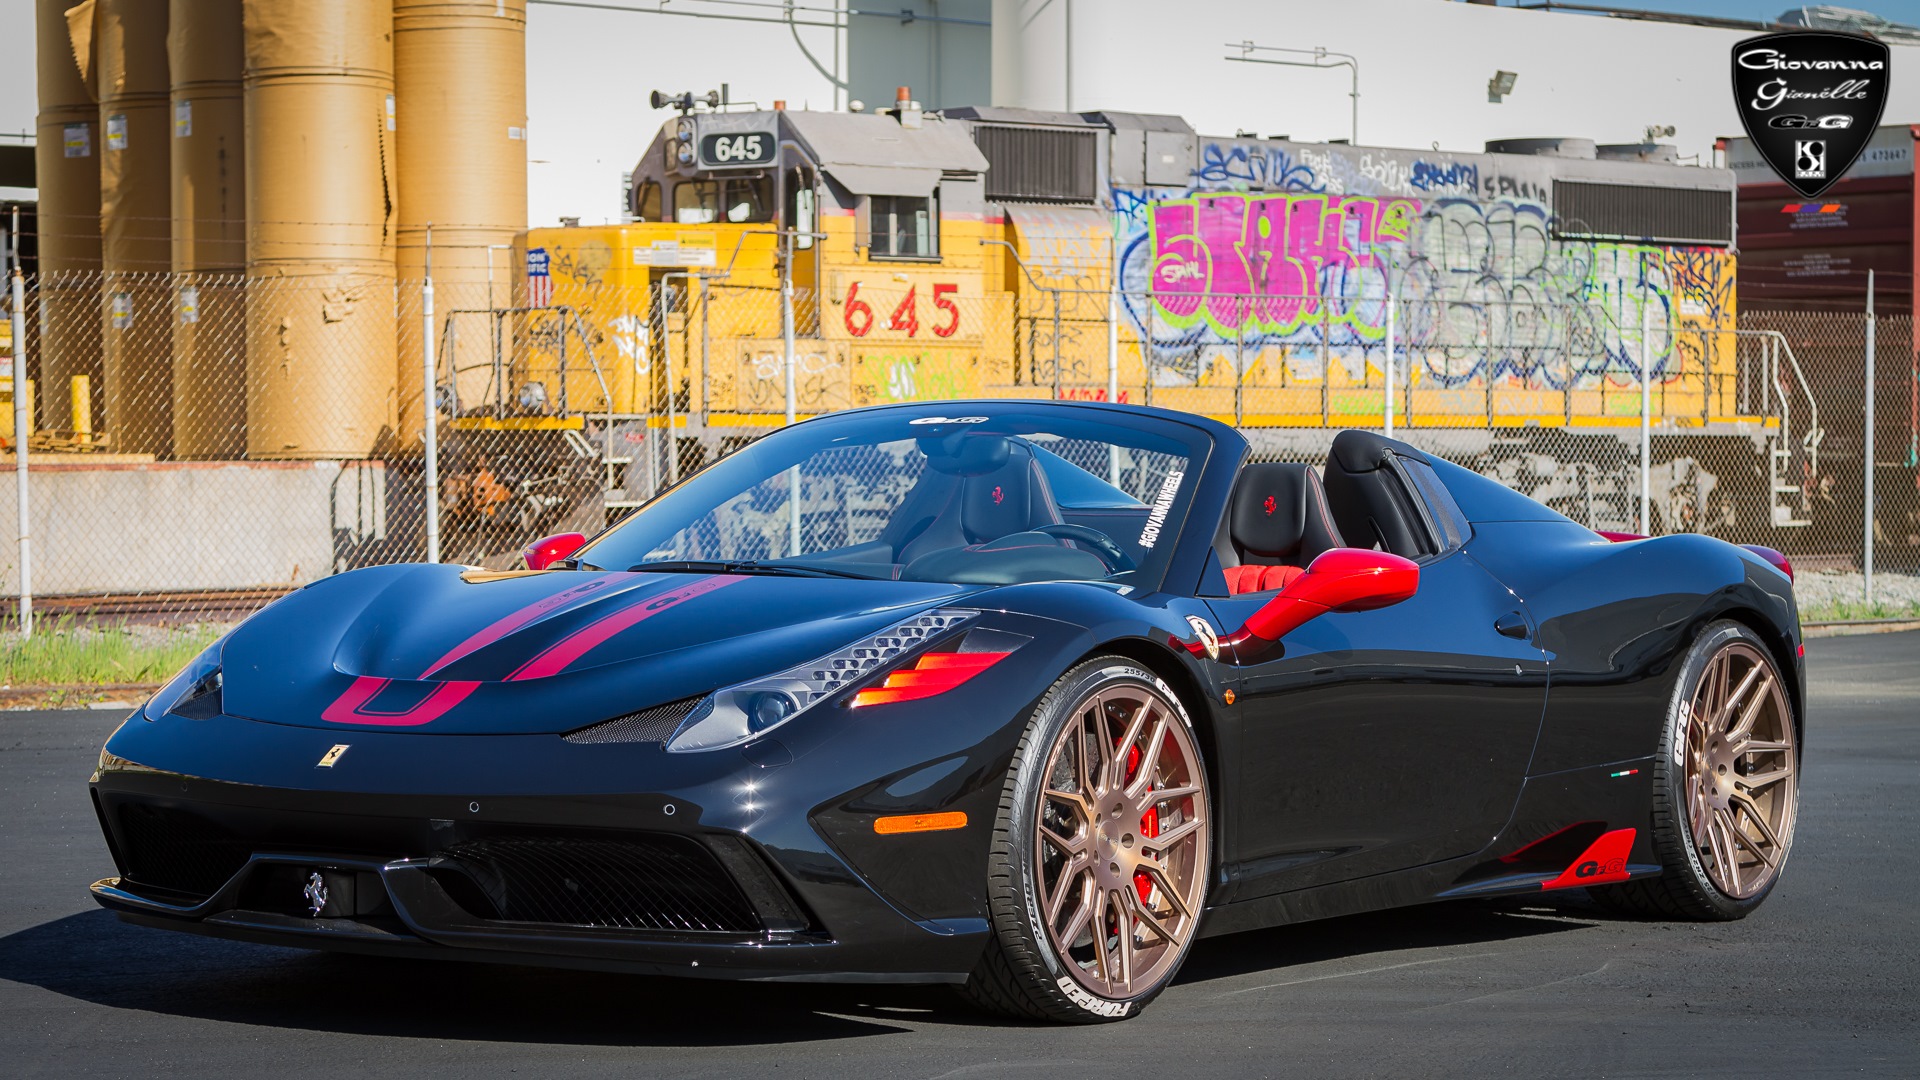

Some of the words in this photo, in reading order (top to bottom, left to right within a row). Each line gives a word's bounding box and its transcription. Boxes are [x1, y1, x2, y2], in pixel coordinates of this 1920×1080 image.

[715, 135, 762, 162] 645
[844, 281, 959, 338] 645
[1138, 470, 1184, 548] #GIOVANNAWHEELS
[1124, 667, 1155, 682] 255/30
[1056, 976, 1132, 1017] FORGED
